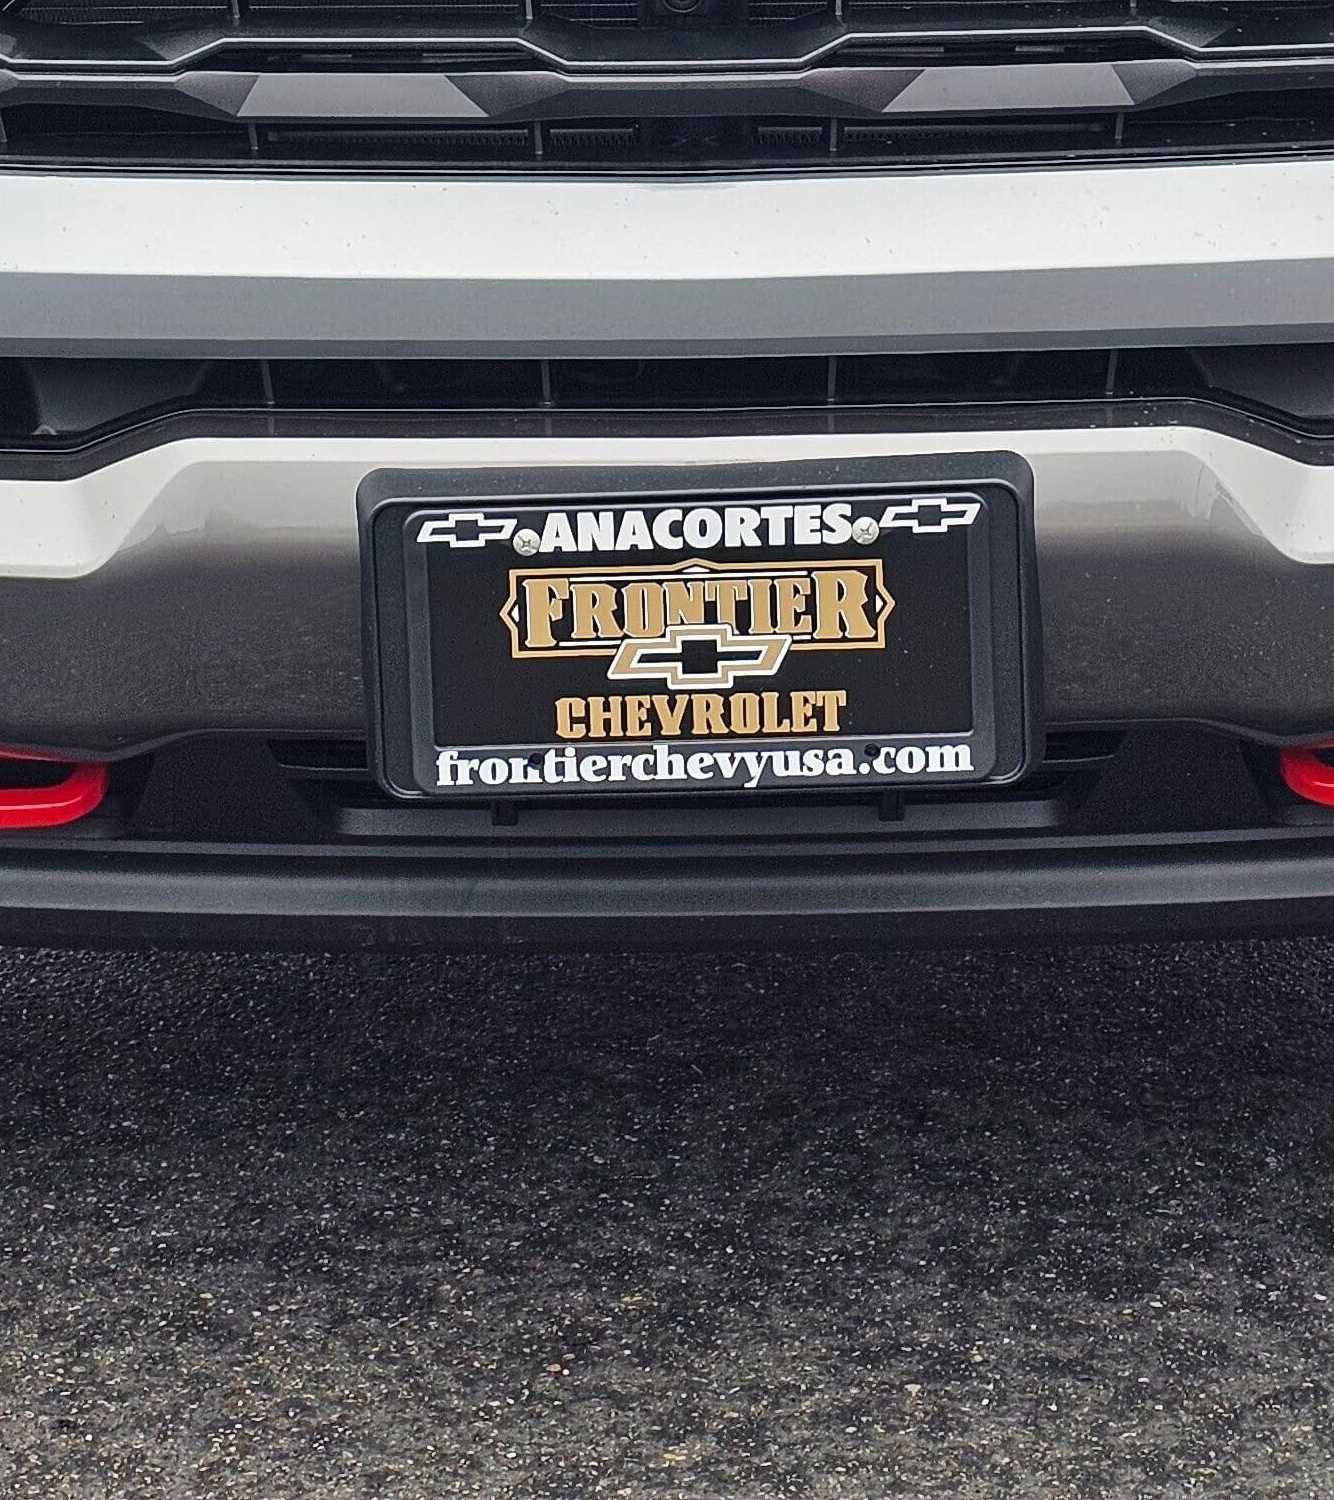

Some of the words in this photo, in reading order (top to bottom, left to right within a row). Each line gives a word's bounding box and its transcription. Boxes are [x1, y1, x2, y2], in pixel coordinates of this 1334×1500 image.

[539, 503, 853, 553] ANACORTES
[522, 569, 872, 649] FRONTIER
[554, 690, 847, 739] CHEVROLET
[436, 741, 974, 789] frontierchevyusa.com
